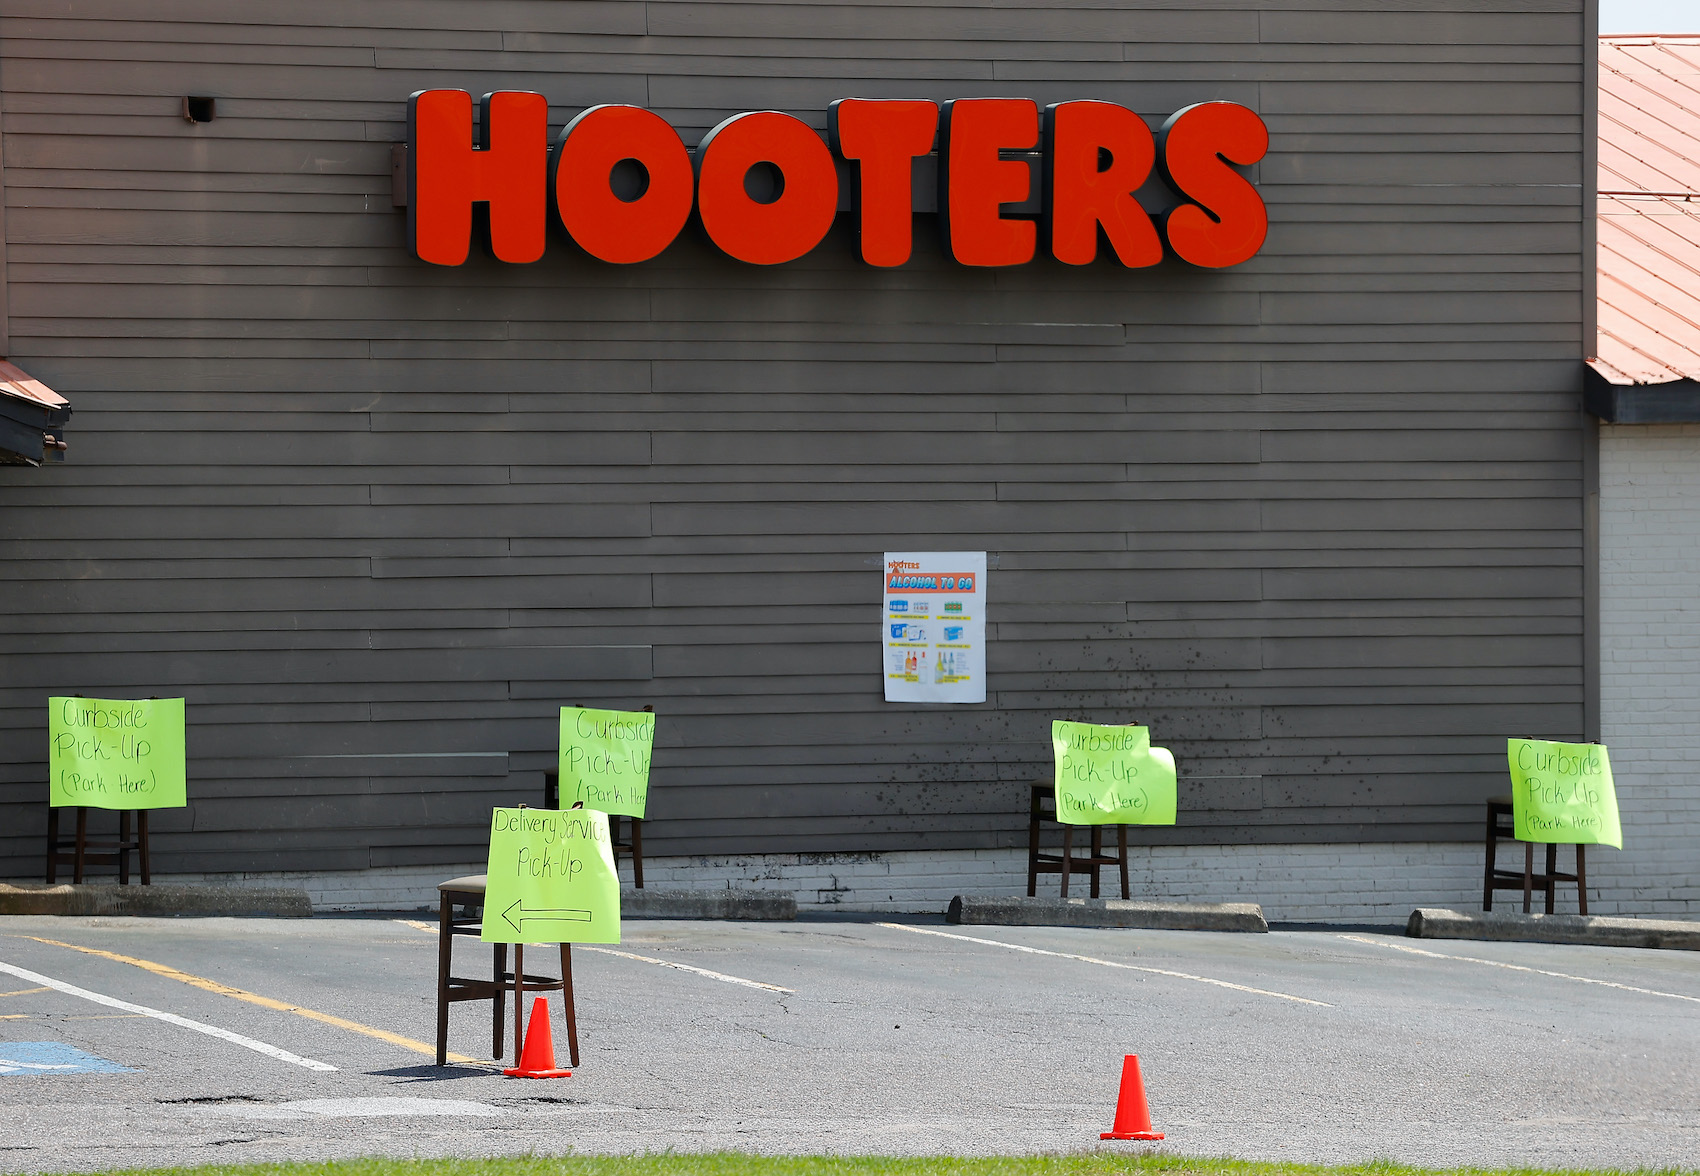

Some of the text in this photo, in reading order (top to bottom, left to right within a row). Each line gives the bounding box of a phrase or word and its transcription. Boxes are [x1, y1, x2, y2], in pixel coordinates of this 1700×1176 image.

[406, 88, 1269, 269] HOOTERS
[888, 561, 920, 569] HOOTERS
[889, 576, 973, 590] ALCOHOL TO GO
[63, 699, 148, 729] Curbside
[1059, 723, 1133, 752] Curbside
[1518, 743, 1602, 776] Curbside
[61, 769, 156, 797] (Park Here)
[494, 809, 557, 844] Delivery
[517, 846, 583, 882] Pick-Up
